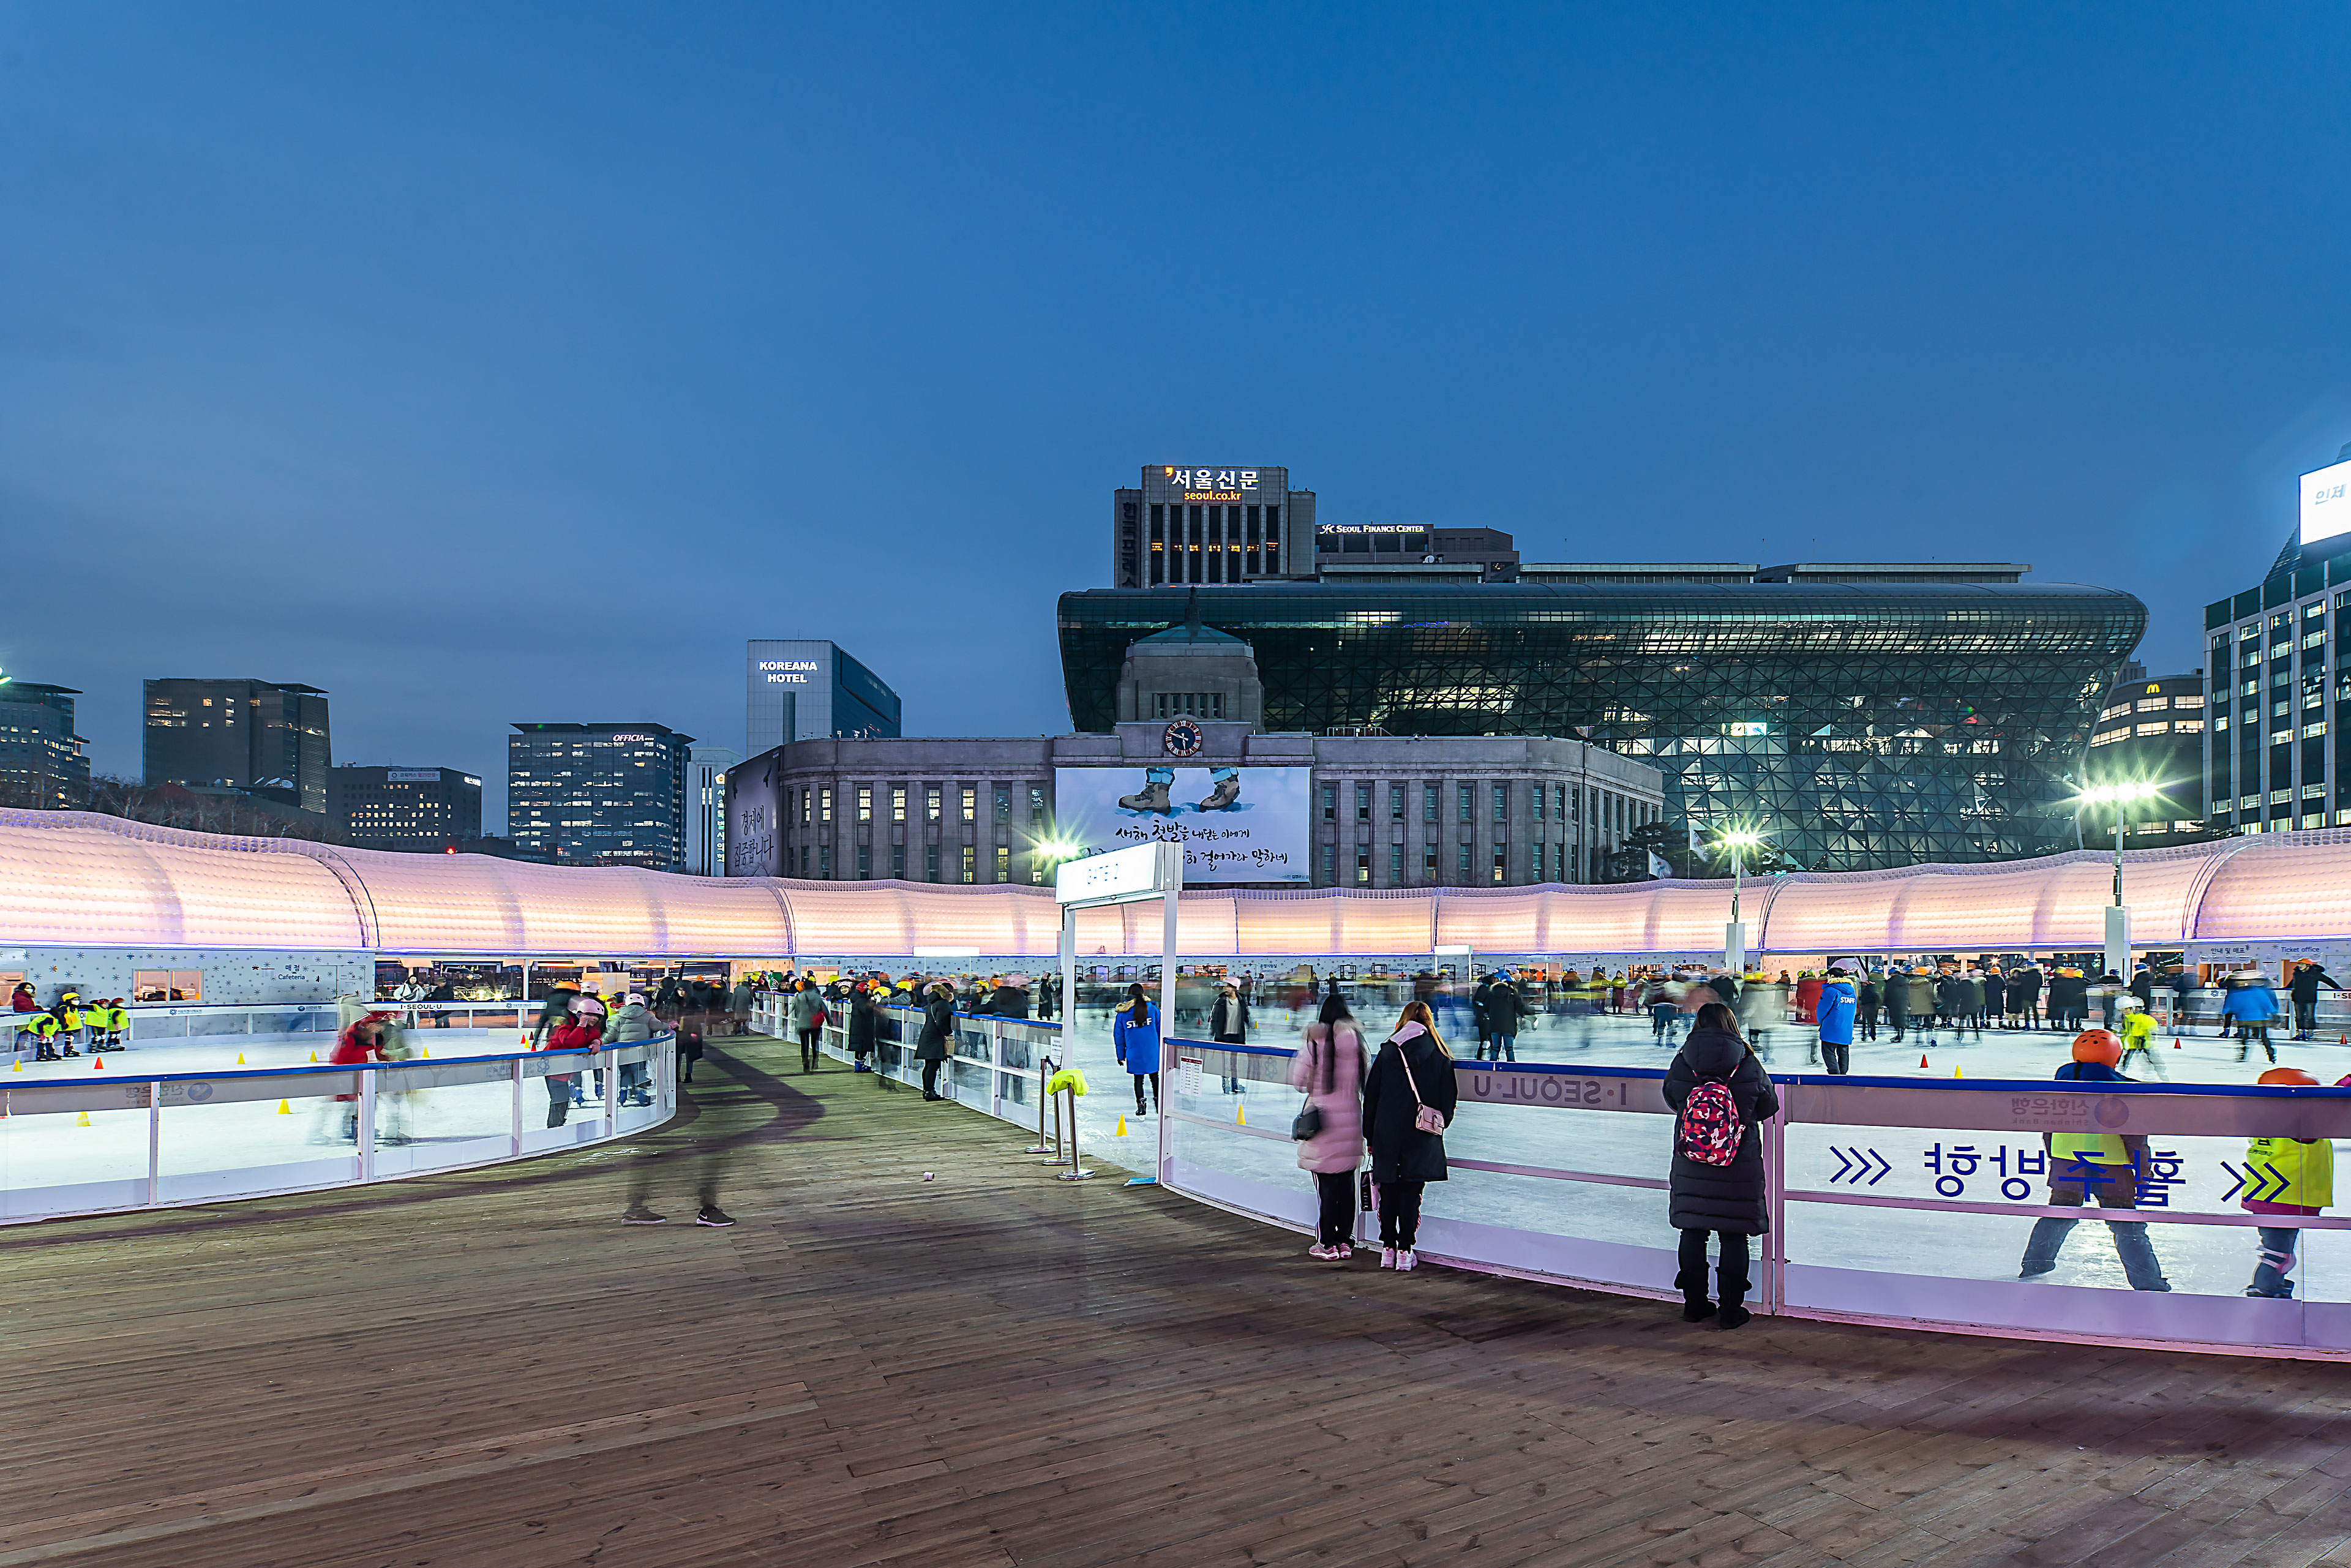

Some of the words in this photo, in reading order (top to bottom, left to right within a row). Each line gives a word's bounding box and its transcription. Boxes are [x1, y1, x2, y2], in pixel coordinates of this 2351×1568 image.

[1184, 490, 1242, 500] seoul.co.kr
[759, 661, 818, 670] KOREANA
[767, 673, 808, 683] HOTEL
[741, 805, 765, 836] 경제에
[1116, 825, 1148, 841] 새해
[1152, 819, 1190, 842] 첫발을
[1221, 828, 1250, 839] 이에게
[735, 834, 774, 868] 집중합니다
[1200, 849, 1248, 872] 걸어가라
[1251, 848, 1288, 868] 말하네
[1127, 1018, 1152, 1029] STF
